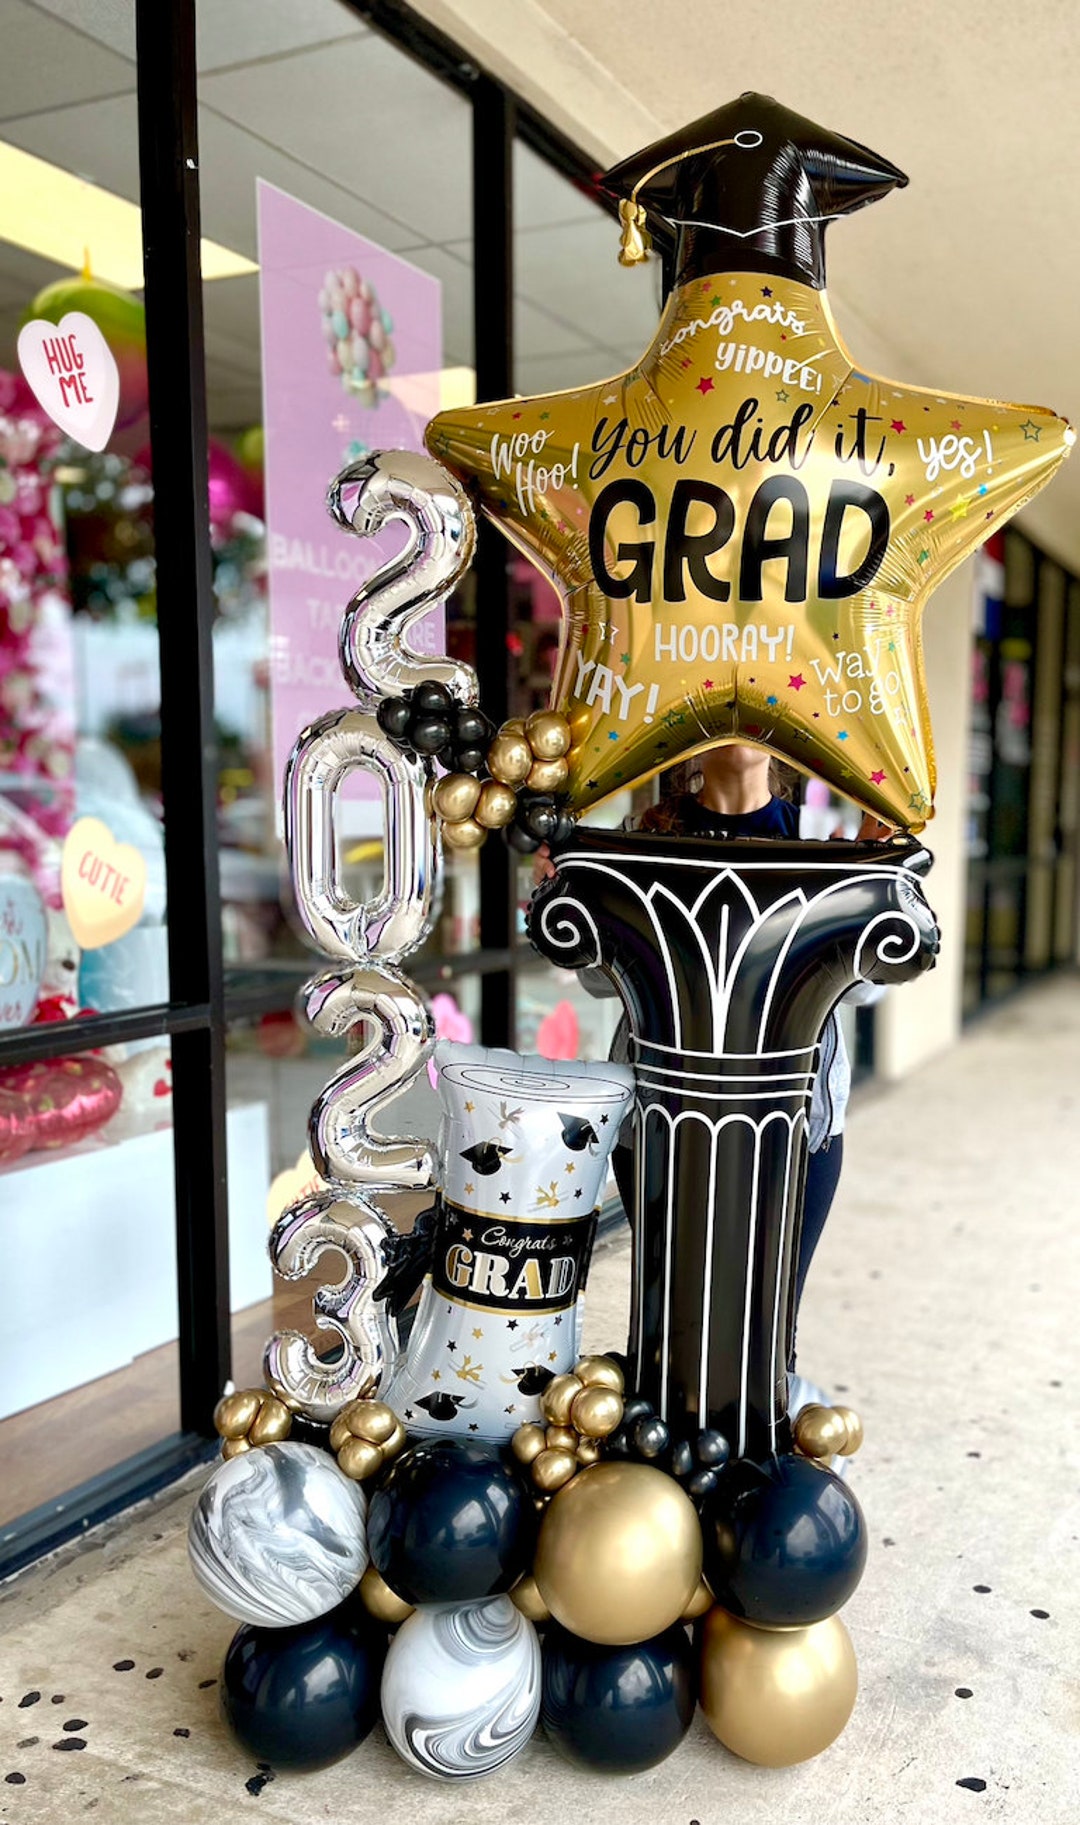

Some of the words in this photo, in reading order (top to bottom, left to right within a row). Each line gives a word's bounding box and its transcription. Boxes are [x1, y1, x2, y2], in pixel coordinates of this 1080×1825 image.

[660, 300, 805, 356] congrats
[42, 334, 84, 376] HUG
[58, 372, 93, 408] ME
[490, 430, 555, 480] Woo
[589, 416, 697, 480] you
[711, 398, 815, 470] did
[835, 408, 896, 477] it,
[917, 430, 993, 482] yes!
[516, 442, 579, 517] Hoo!
[271, 532, 378, 581] BALLOO
[588, 474, 890, 604] GRAD
[655, 623, 795, 662] HOORAY!
[574, 650, 660, 724] YAY!
[823, 688, 862, 717] to
[868, 671, 900, 715] go
[78, 851, 130, 906] CUTIE
[481, 1226, 557, 1258] Congrats
[445, 1243, 576, 1299] GRAD
